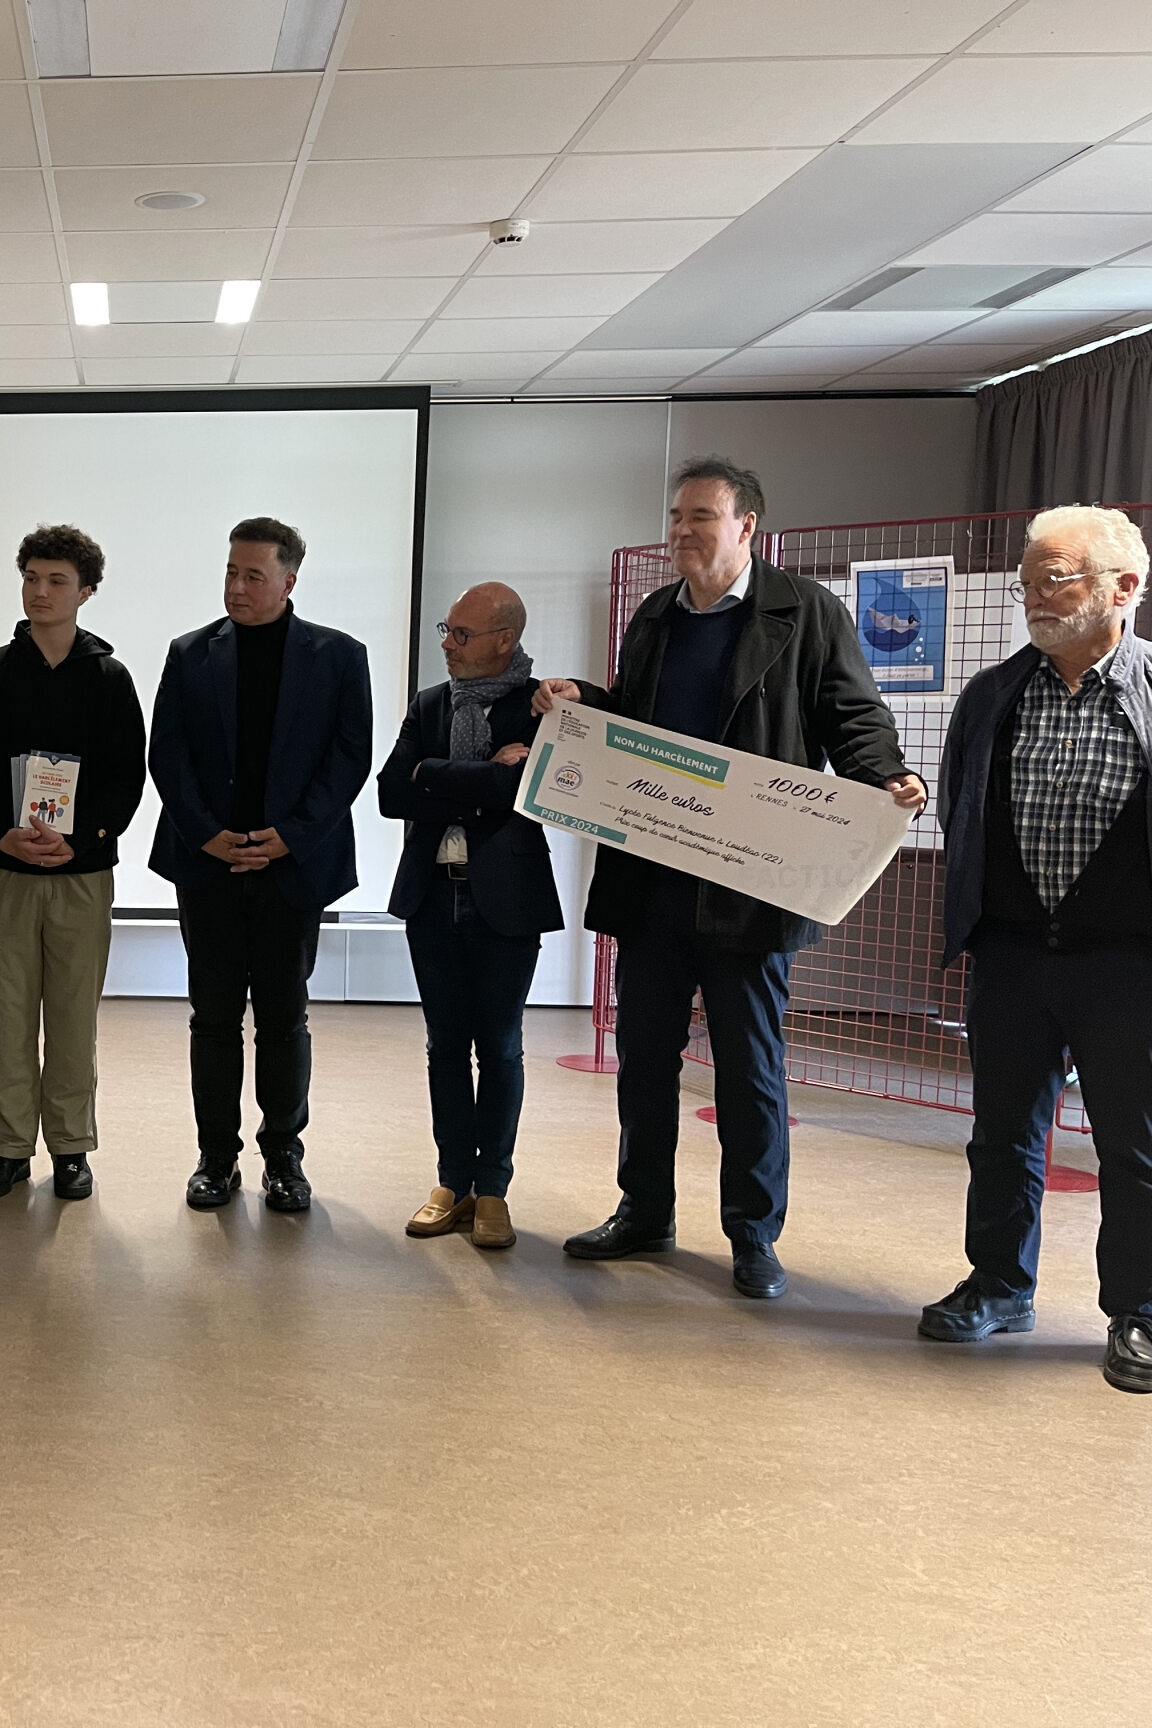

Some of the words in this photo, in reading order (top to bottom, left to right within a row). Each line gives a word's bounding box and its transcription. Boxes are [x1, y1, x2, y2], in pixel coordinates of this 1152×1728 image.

[614, 735, 635, 748] NON
[636, 743, 650, 753] AU
[557, 776, 576, 787] mae
[768, 778, 823, 801] 1000
[626, 778, 669, 801] Mille
[671, 796, 715, 816] euros
[756, 793, 788, 807] RENNES
[826, 814, 851, 826] 2024
[540, 809, 569, 825] PRIX
[569, 818, 599, 835] 2024
[761, 852, 784, 865] (22)
